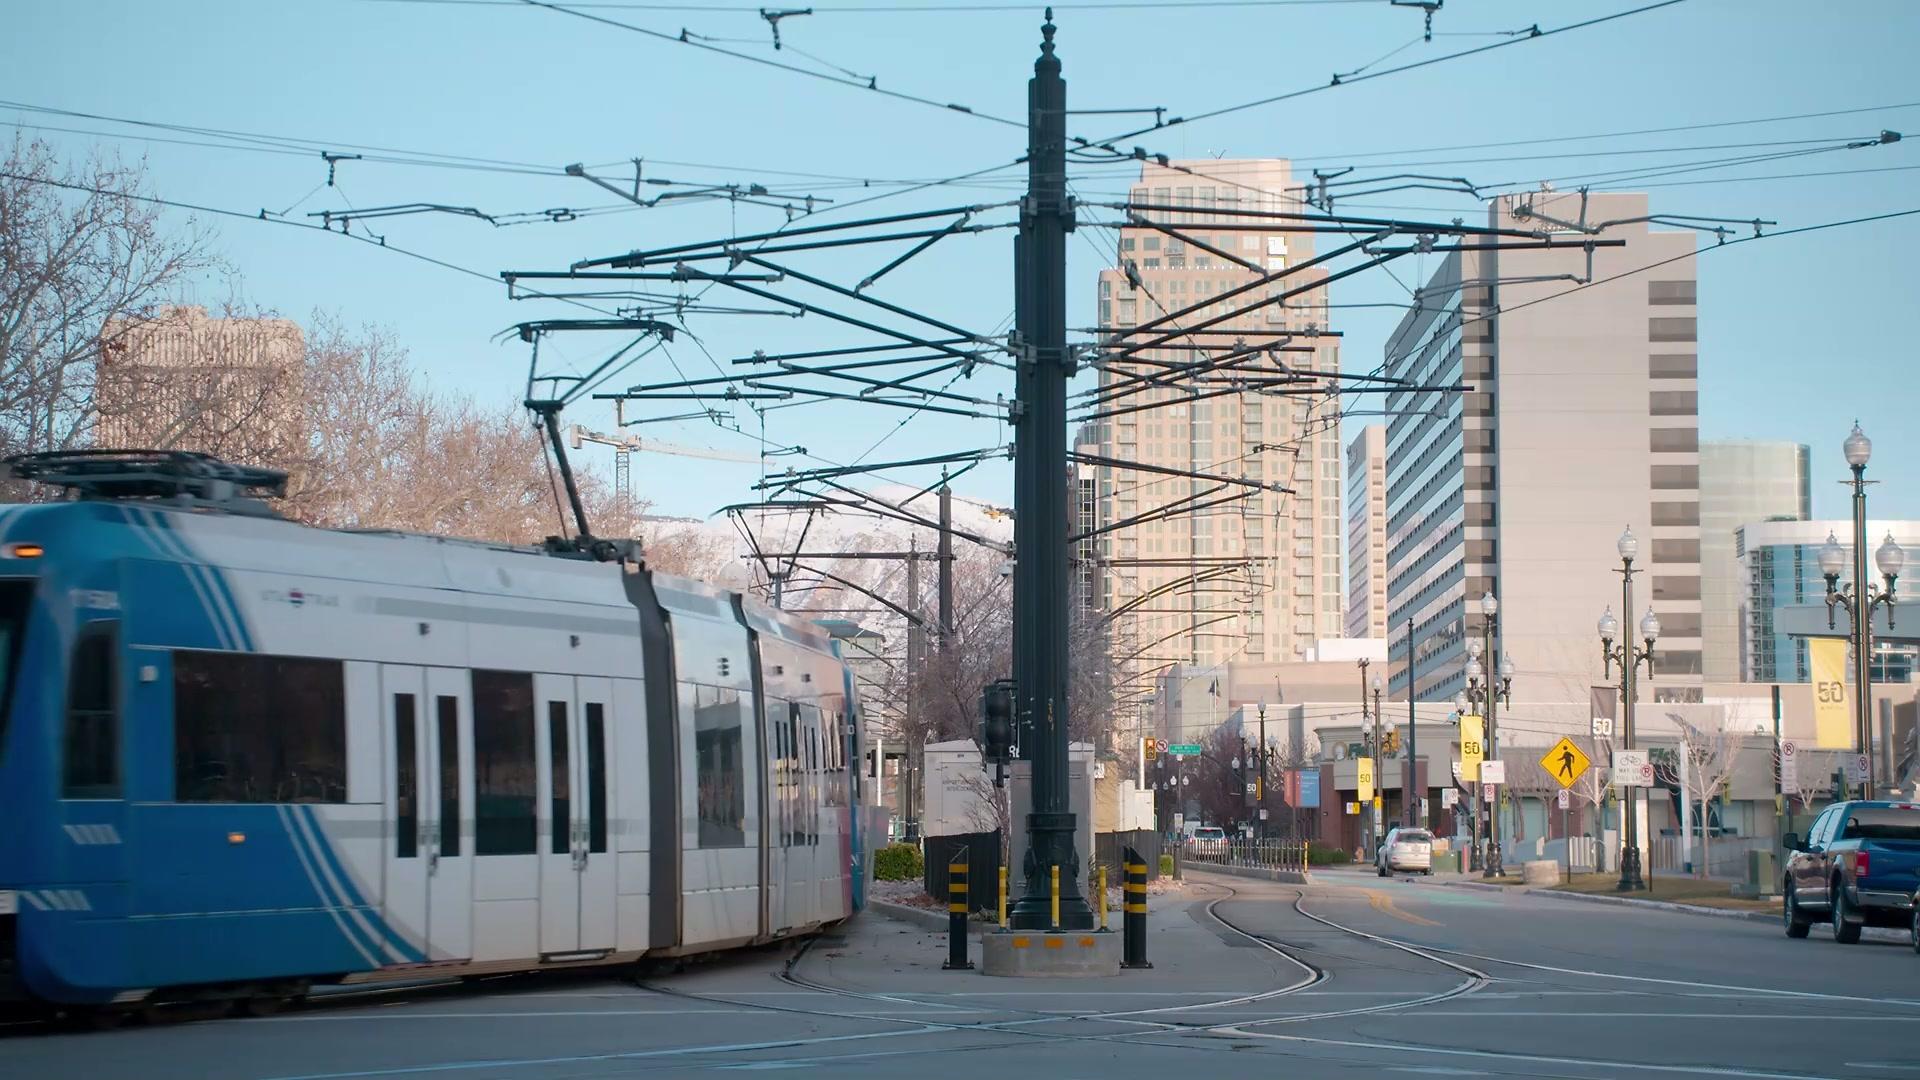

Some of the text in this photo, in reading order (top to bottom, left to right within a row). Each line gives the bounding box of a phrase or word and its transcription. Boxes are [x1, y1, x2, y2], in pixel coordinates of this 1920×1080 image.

[1818, 682, 1844, 703] 50
[1592, 718, 1612, 735] 50
[1464, 742, 1480, 755] 50
[1360, 774, 1370, 783] 50
[1247, 783, 1256, 792] 50
